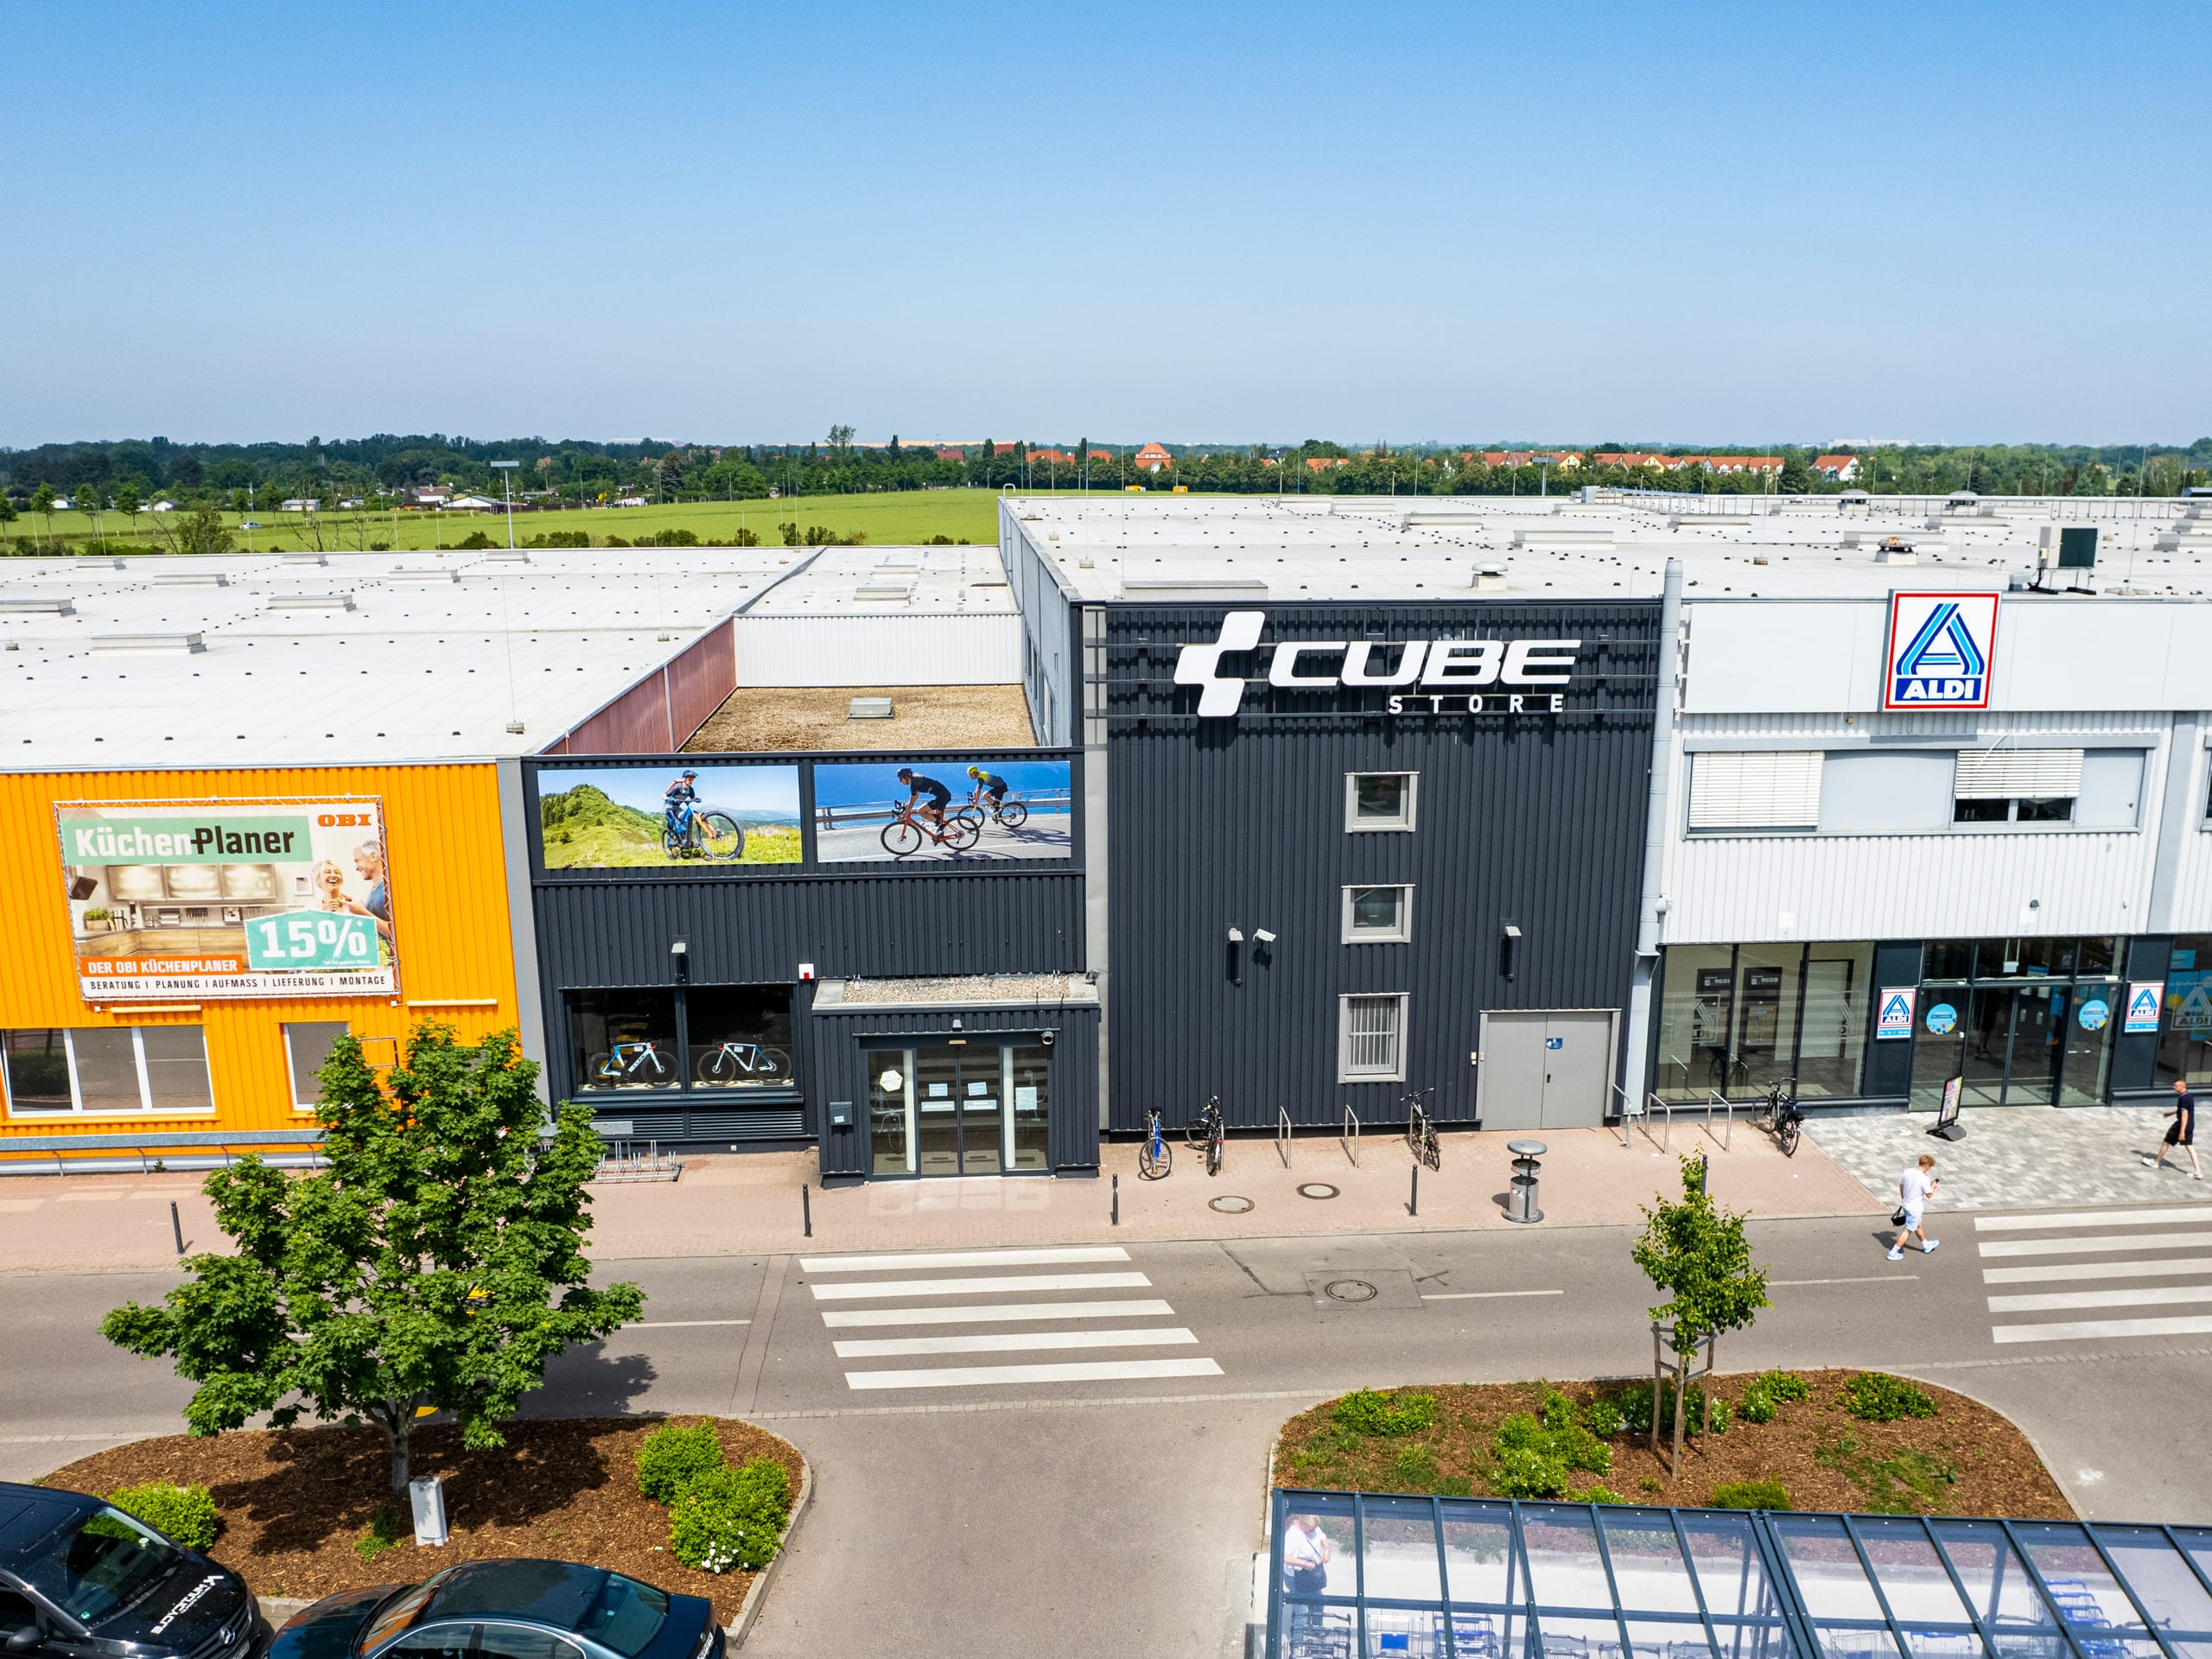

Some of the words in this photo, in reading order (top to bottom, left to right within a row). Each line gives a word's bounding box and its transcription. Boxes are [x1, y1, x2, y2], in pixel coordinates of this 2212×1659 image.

[1268, 639, 1581, 687] CUBE
[1902, 679, 1975, 699] ALDI
[1388, 694, 1564, 715] STORE
[317, 814, 372, 827] OBI
[88, 961, 113, 974] DER
[116, 961, 137, 974] OBI
[141, 958, 238, 973] KÜCHENPLANER
[90, 980, 140, 990] BERATUNG
[156, 979, 200, 988] PLANUNG
[213, 978, 258, 988] AUFMASS
[272, 977, 325, 987] LIEFERUNG
[340, 976, 385, 985] MONTAGE
